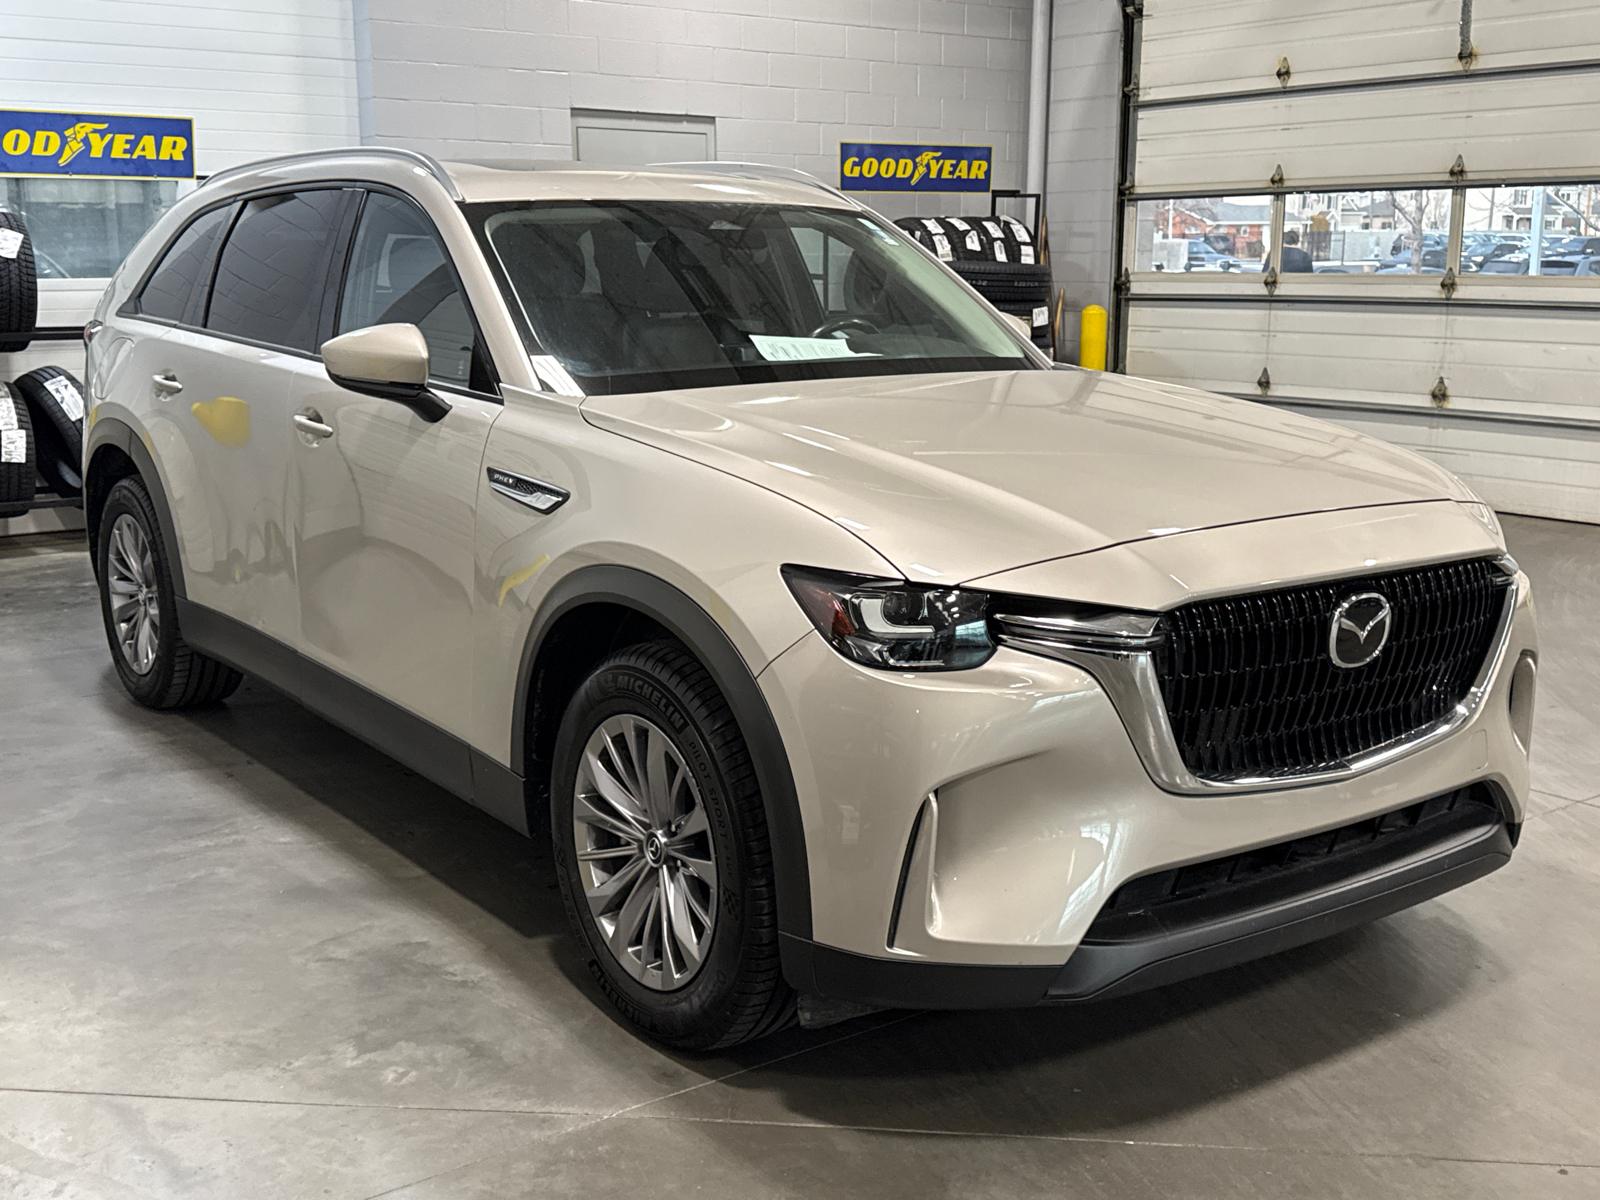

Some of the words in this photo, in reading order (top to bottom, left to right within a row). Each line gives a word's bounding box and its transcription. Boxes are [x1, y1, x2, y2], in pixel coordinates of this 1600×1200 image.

[617, 675, 684, 729] MICHELIN
[688, 741, 712, 781] PILOT
[708, 787, 728, 839] SPORT
